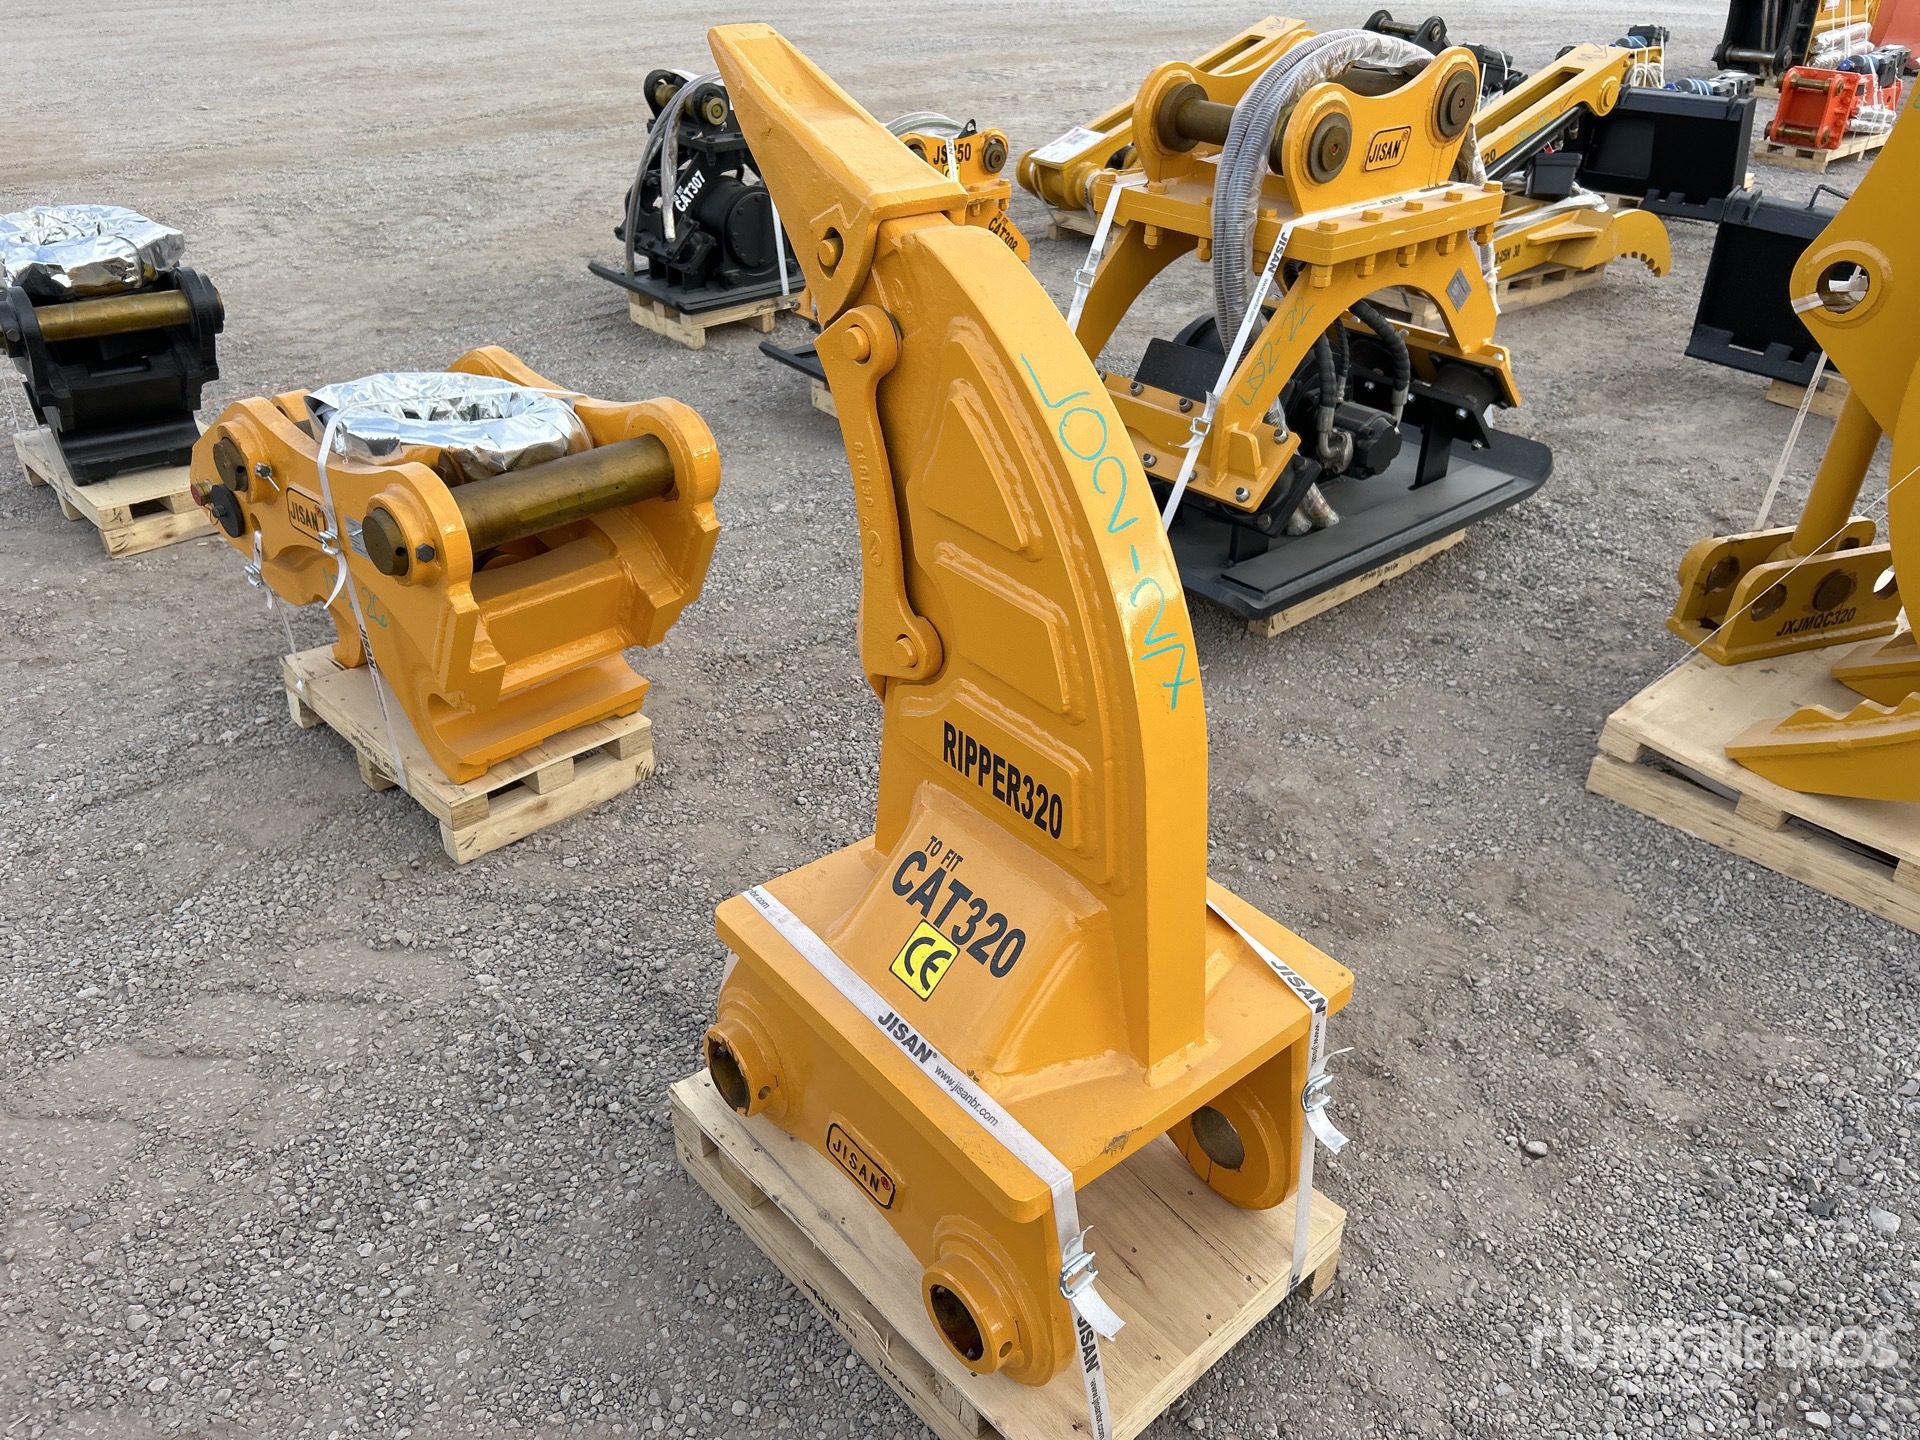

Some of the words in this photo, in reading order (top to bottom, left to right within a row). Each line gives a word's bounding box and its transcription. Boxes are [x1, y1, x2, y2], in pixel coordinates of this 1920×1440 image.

[933, 143, 971, 165] JS50
[1369, 140, 1401, 163] JISAN
[675, 170, 706, 212] CAT307
[1267, 232, 1288, 275] JISAN
[290, 502, 320, 533] JISAN
[359, 624, 376, 670] JISAN
[942, 720, 1063, 839] RIPPER320
[925, 835, 943, 857] TO
[940, 849, 963, 872] FIT
[892, 850, 1026, 978] CAT320
[904, 936, 952, 992] CE
[1271, 960, 1326, 1014] JISAN
[878, 1012, 933, 1063] JISAN
[934, 1065, 999, 1126] www.jisanbr.com
[833, 1139, 879, 1193] JISAN
[1077, 1316, 1098, 1374] JISAN
